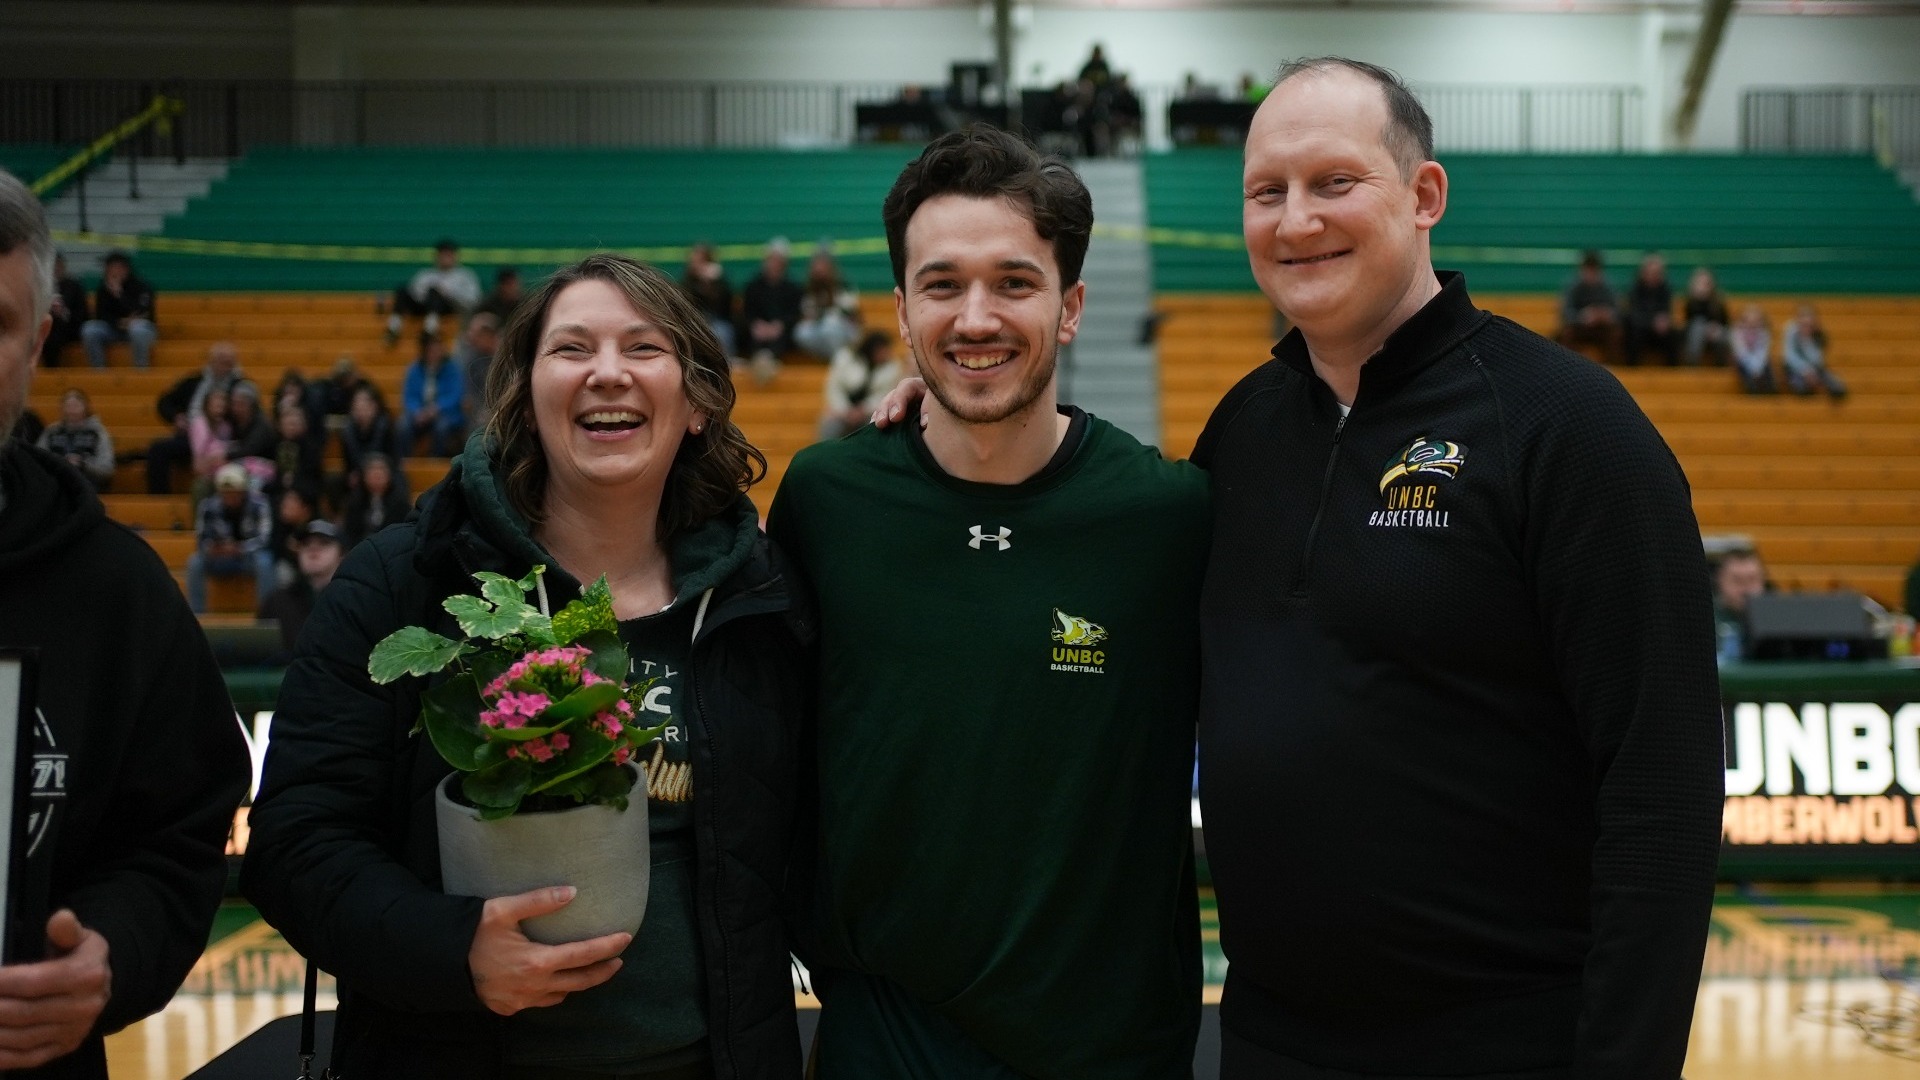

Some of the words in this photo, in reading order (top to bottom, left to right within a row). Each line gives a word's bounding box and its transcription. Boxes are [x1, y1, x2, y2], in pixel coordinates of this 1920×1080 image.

[1388, 485, 1437, 509] UNBC
[1368, 509, 1449, 527] BASKETBALL
[1052, 647, 1105, 665] UNBC
[1050, 663, 1105, 674] BASKETBALL
[31, 760, 66, 788] 71
